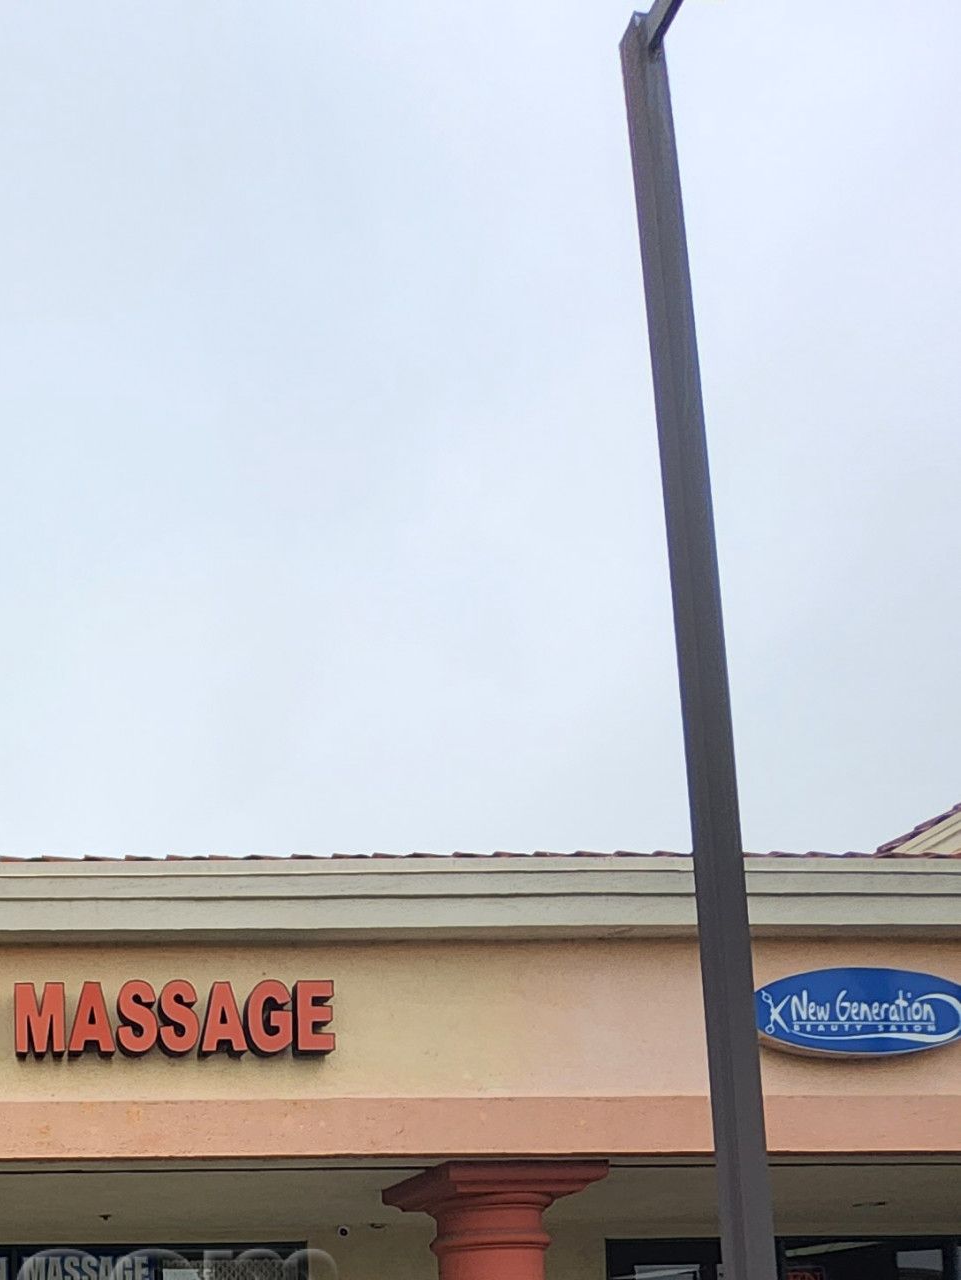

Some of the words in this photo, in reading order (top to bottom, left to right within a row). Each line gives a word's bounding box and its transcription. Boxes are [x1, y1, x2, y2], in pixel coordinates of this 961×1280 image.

[12, 979, 337, 1059] MASSAGE
[791, 989, 830, 1021] New
[836, 989, 936, 1022] Generation
[793, 1024, 863, 1032] BEAUTY
[878, 1024, 937, 1032] SALON
